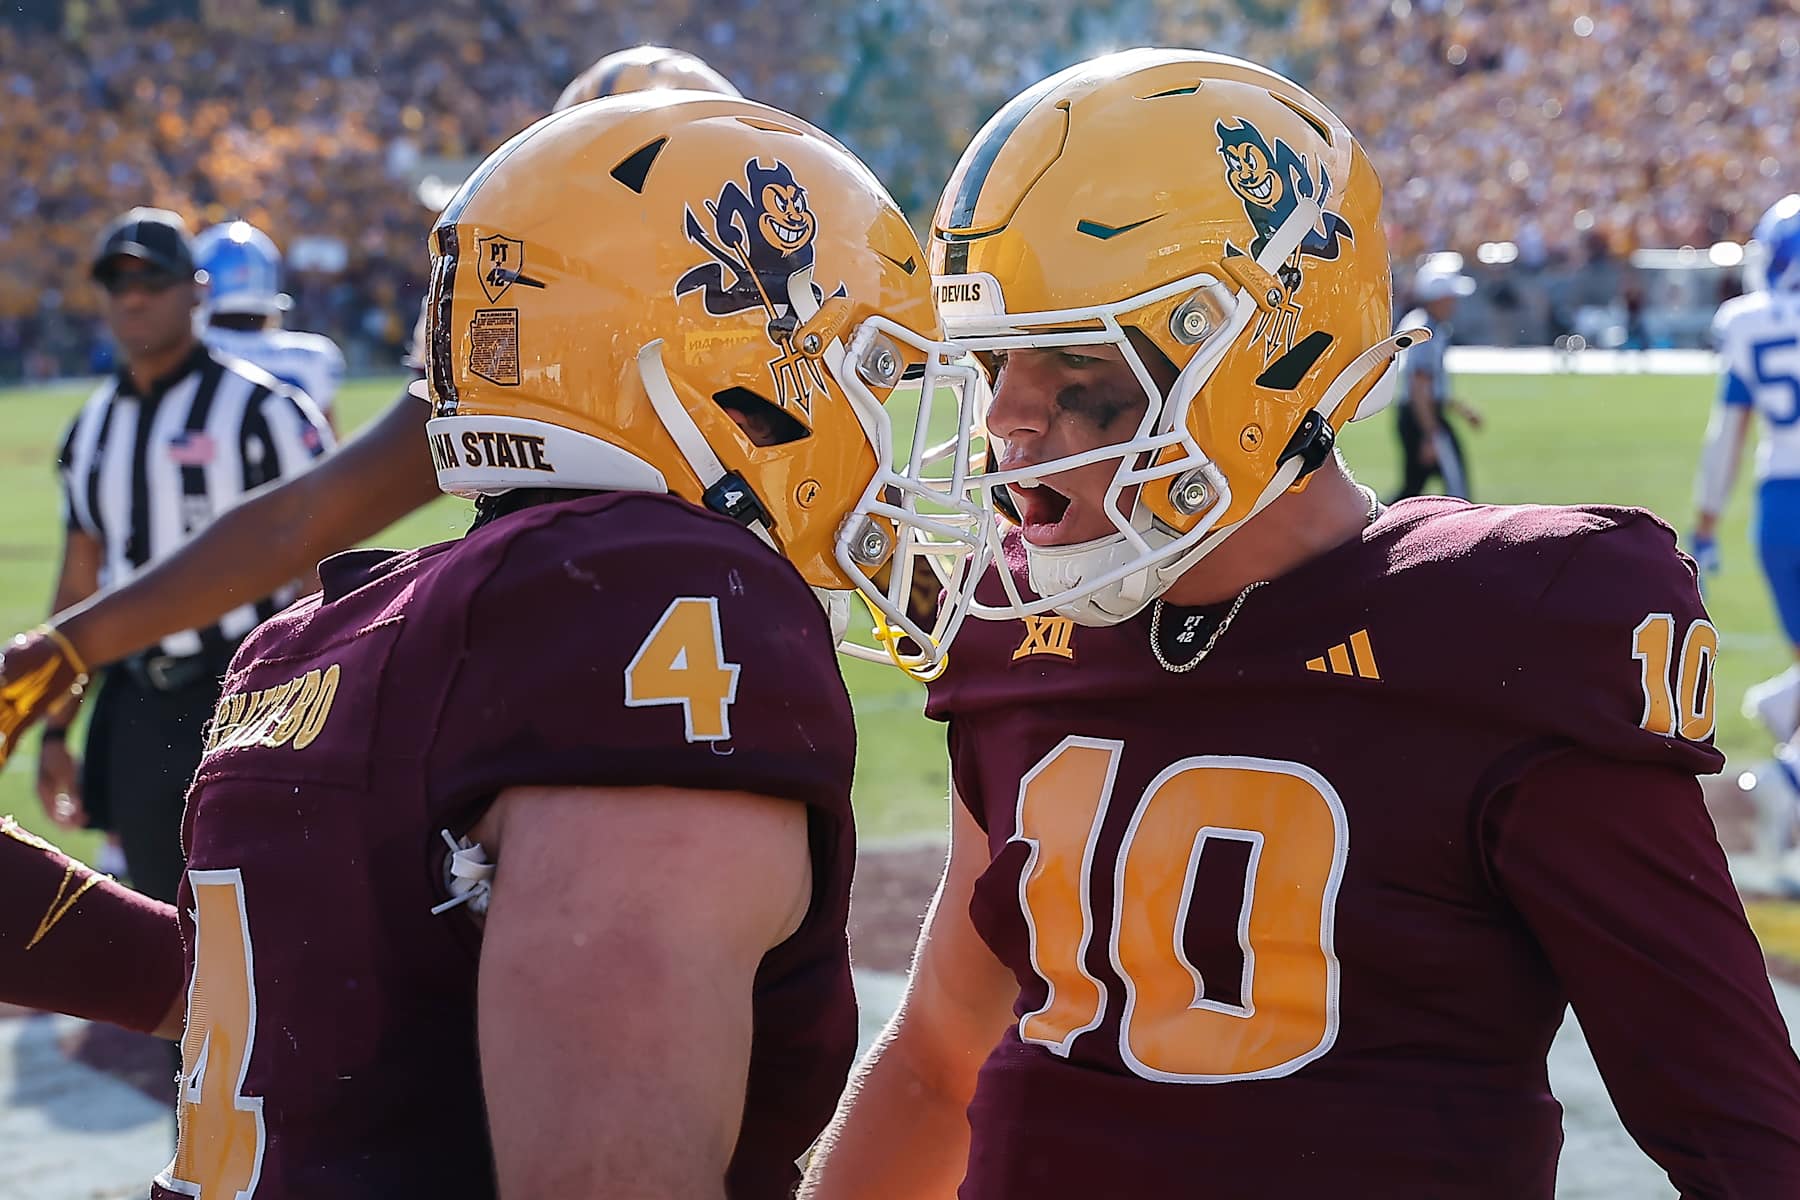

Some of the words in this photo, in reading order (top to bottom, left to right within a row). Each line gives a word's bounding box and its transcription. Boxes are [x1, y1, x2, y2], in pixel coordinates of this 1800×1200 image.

[490, 243, 509, 262] PT
[486, 268, 507, 287] 42
[941, 283, 981, 303] DEVILS
[461, 430, 556, 473] STATE
[1012, 615, 1074, 661] XII
[1176, 631, 1195, 643] 42
[1183, 615, 1204, 627] PT
[624, 596, 741, 743] 4
[1632, 613, 1719, 742] 10
[1006, 735, 1349, 1084] 10
[151, 868, 266, 1200] 4
